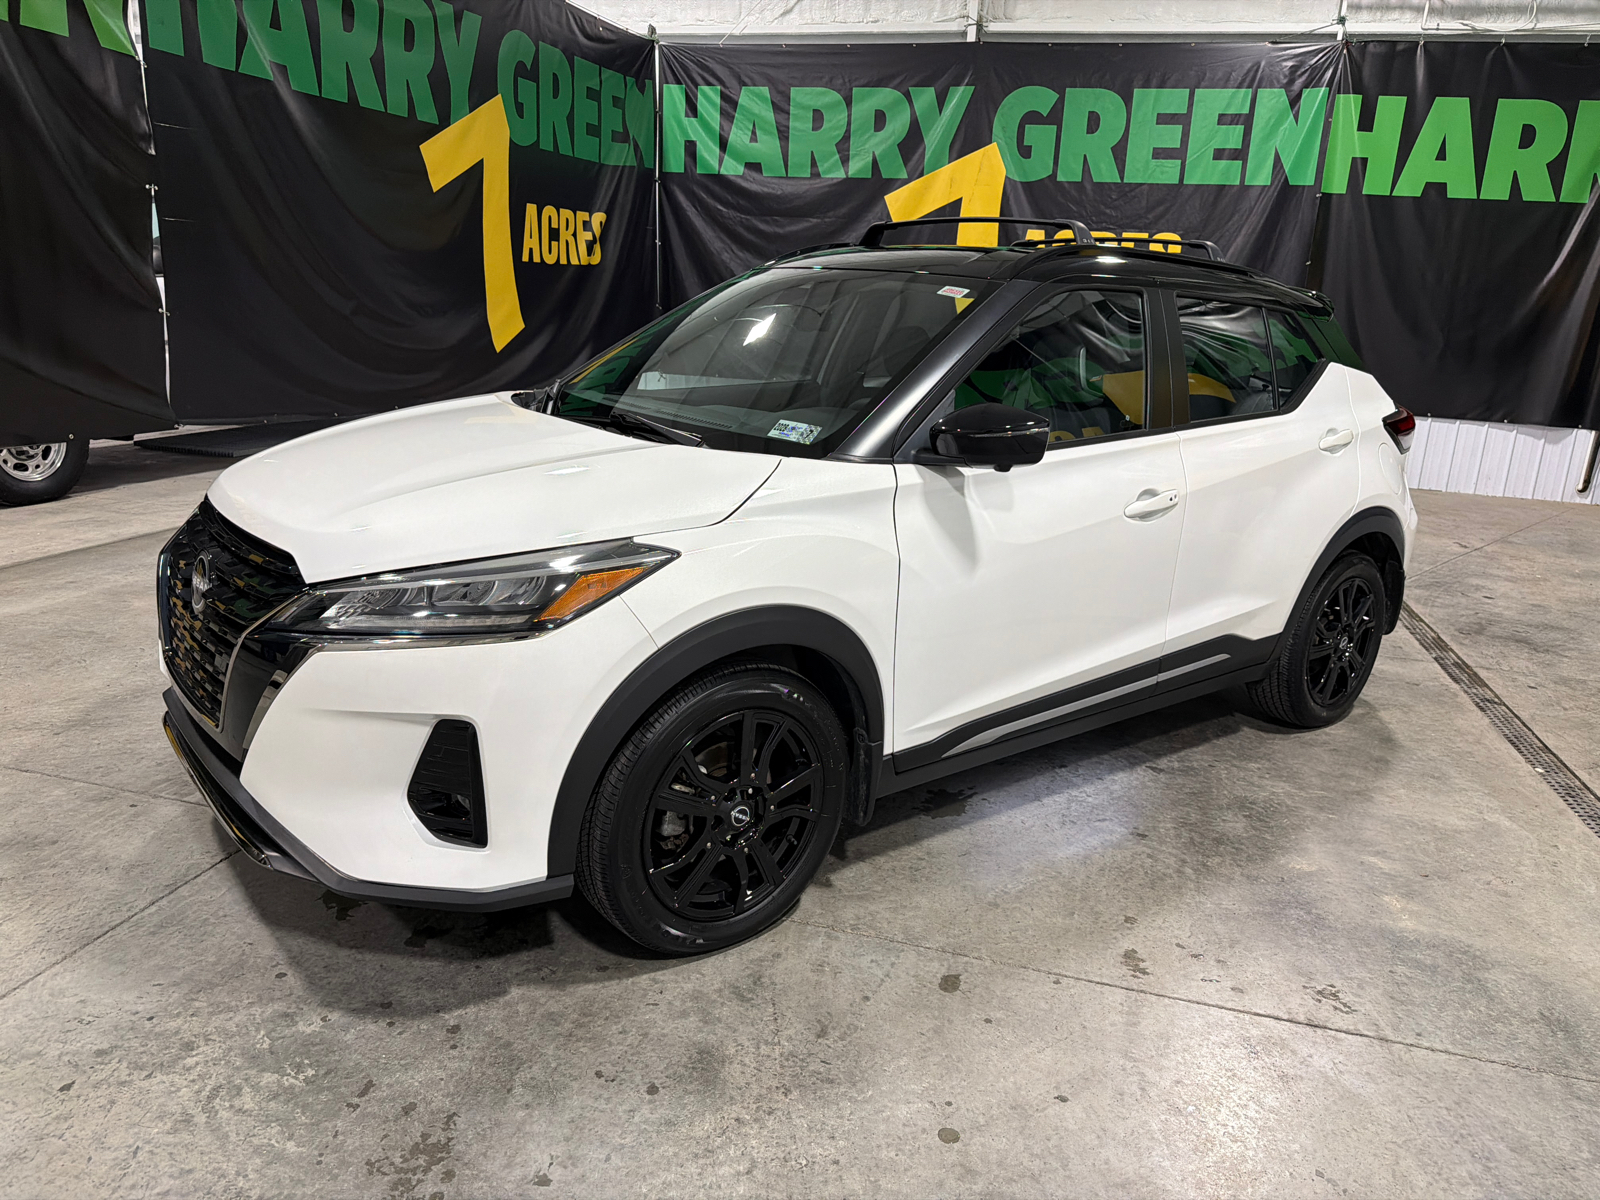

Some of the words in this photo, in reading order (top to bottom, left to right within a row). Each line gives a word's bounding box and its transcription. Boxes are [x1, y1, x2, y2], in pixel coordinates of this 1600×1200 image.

[497, 29, 655, 169] GREEN
[662, 85, 976, 179] HARRY
[992, 85, 1330, 185] GREEN
[522, 203, 607, 265] ACRES
